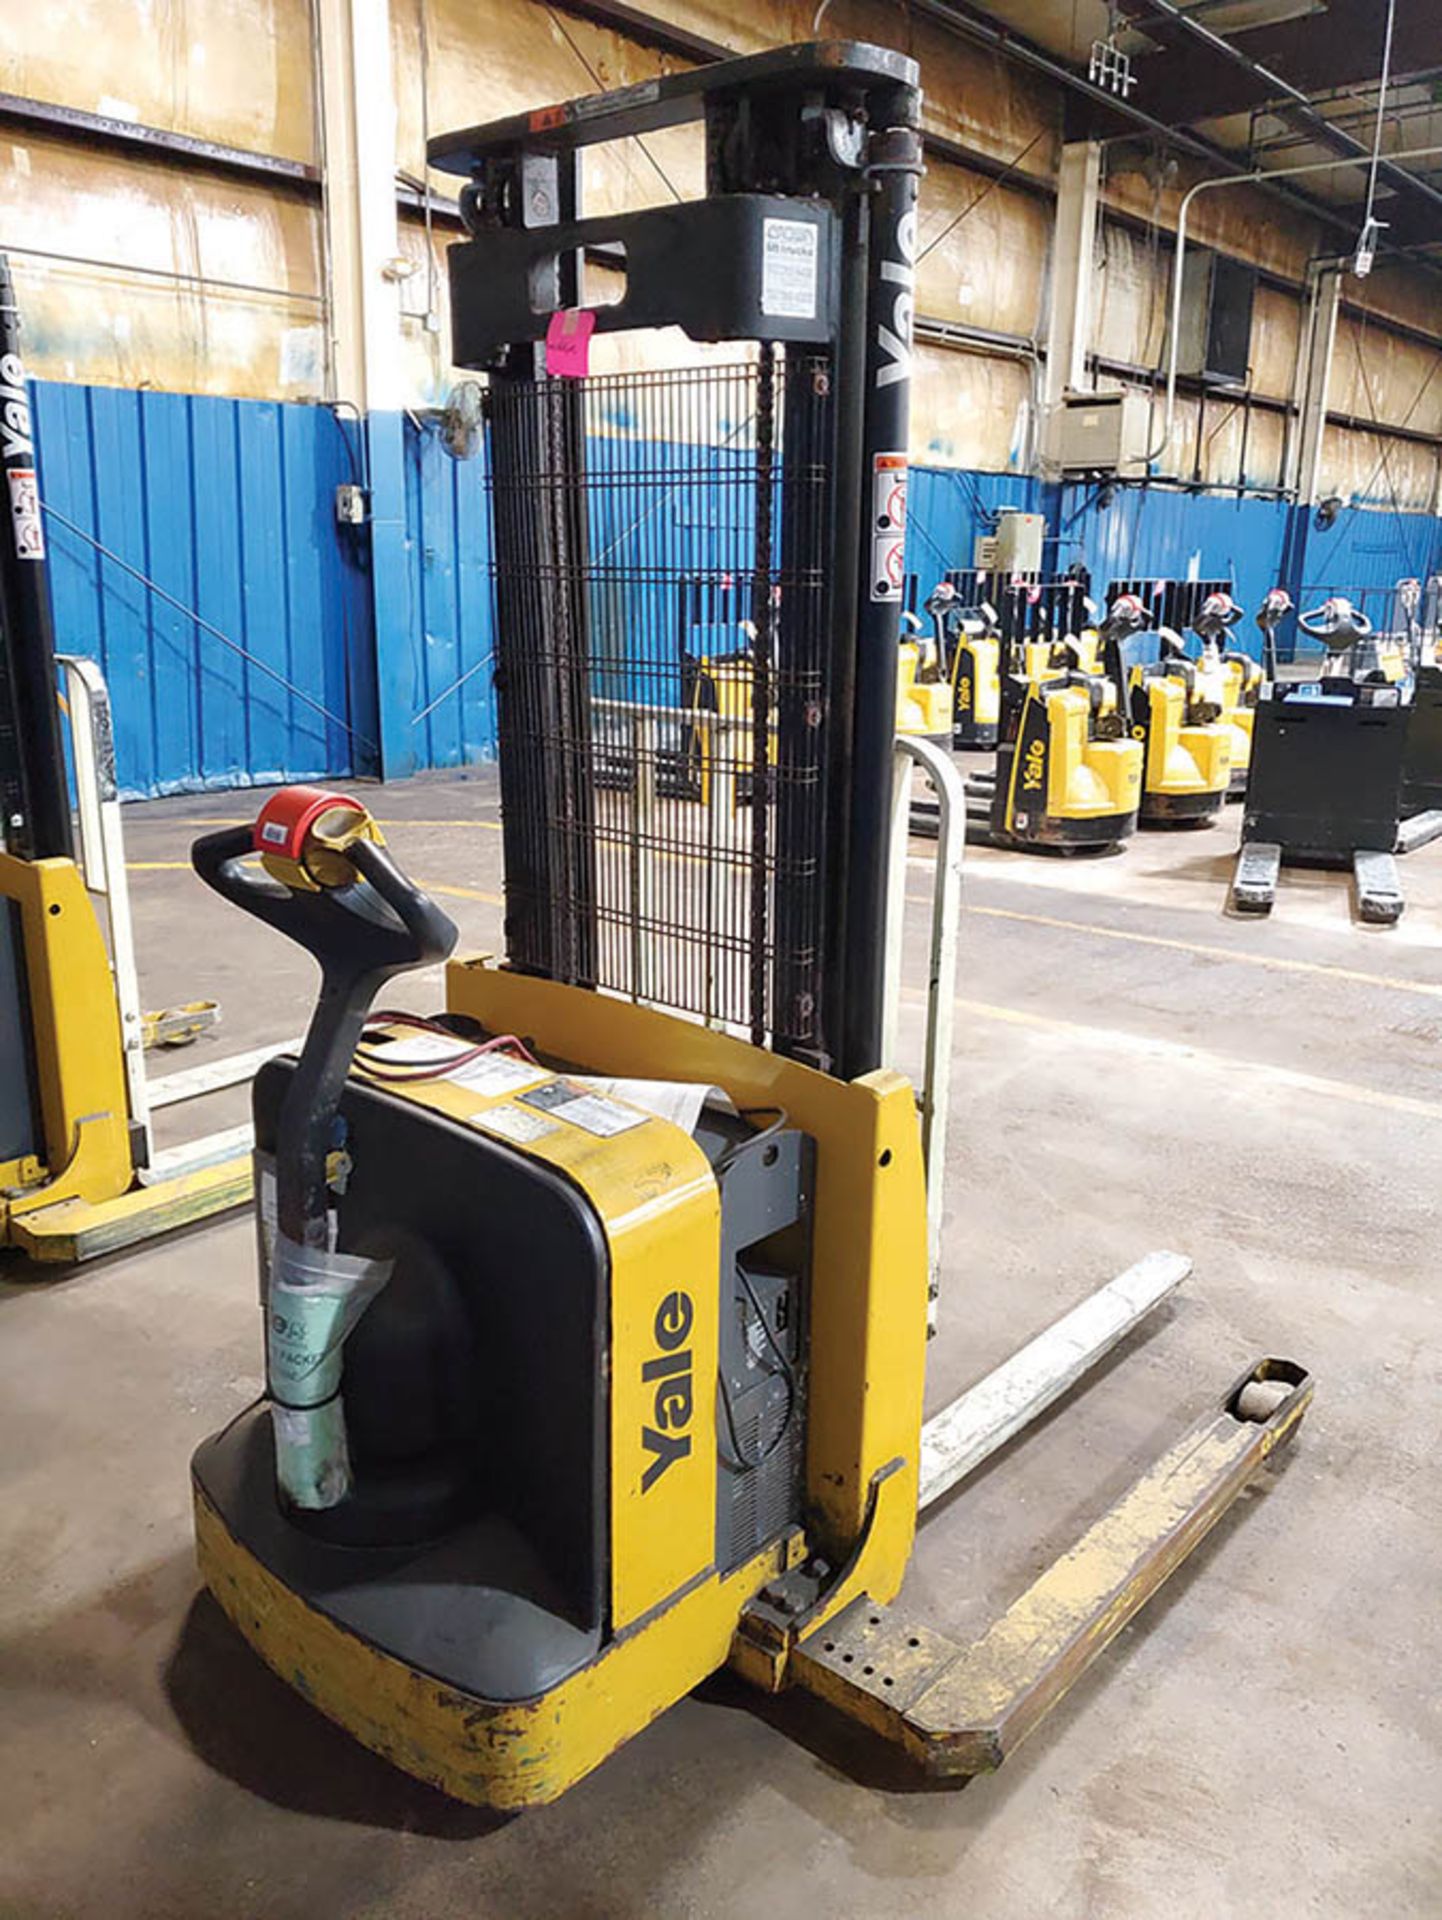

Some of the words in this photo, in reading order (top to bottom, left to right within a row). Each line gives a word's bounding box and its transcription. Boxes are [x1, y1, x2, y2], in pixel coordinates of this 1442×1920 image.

[0, 353, 34, 457] Yale
[958, 677, 971, 711] Yale
[1023, 740, 1046, 791] Yale
[641, 1290, 693, 1495] Yale
